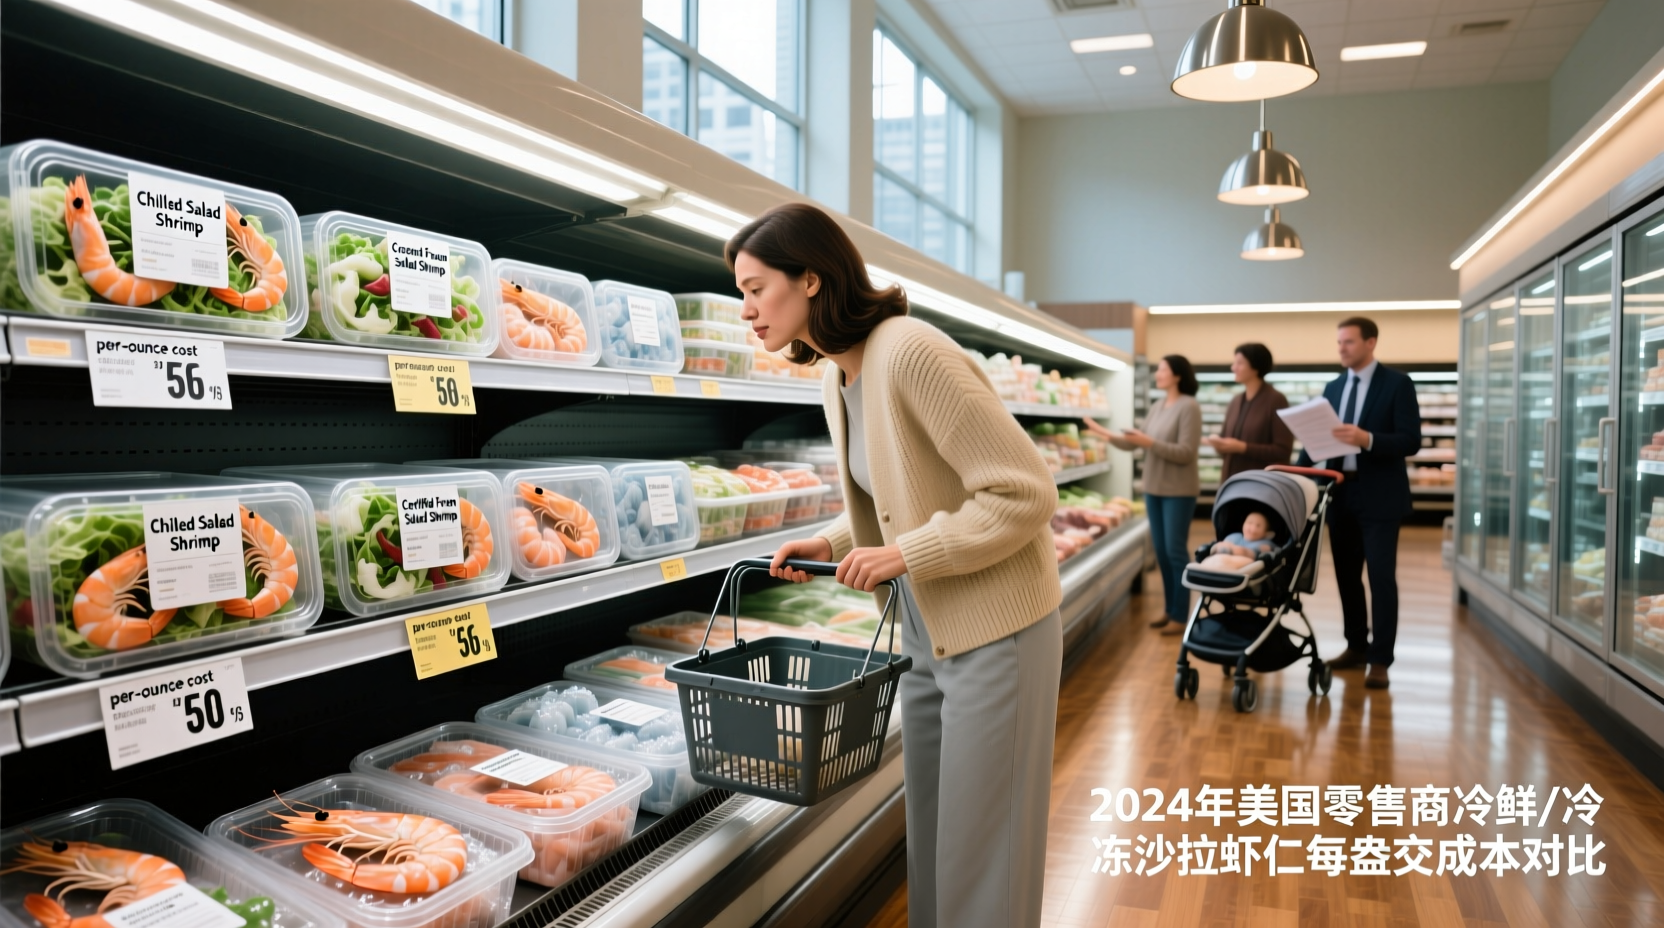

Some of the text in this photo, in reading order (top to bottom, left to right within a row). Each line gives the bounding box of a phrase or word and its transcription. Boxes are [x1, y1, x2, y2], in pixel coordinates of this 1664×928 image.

[186, 200, 221, 219] Salad
[155, 212, 204, 238] Shrimp
[96, 340, 198, 356] per-ounce cost
[166, 361, 205, 401] 56
[170, 535, 221, 552] Shrimp
[110, 680, 184, 710] per-ounce
[187, 670, 214, 687] cost
[184, 688, 225, 734] 50
